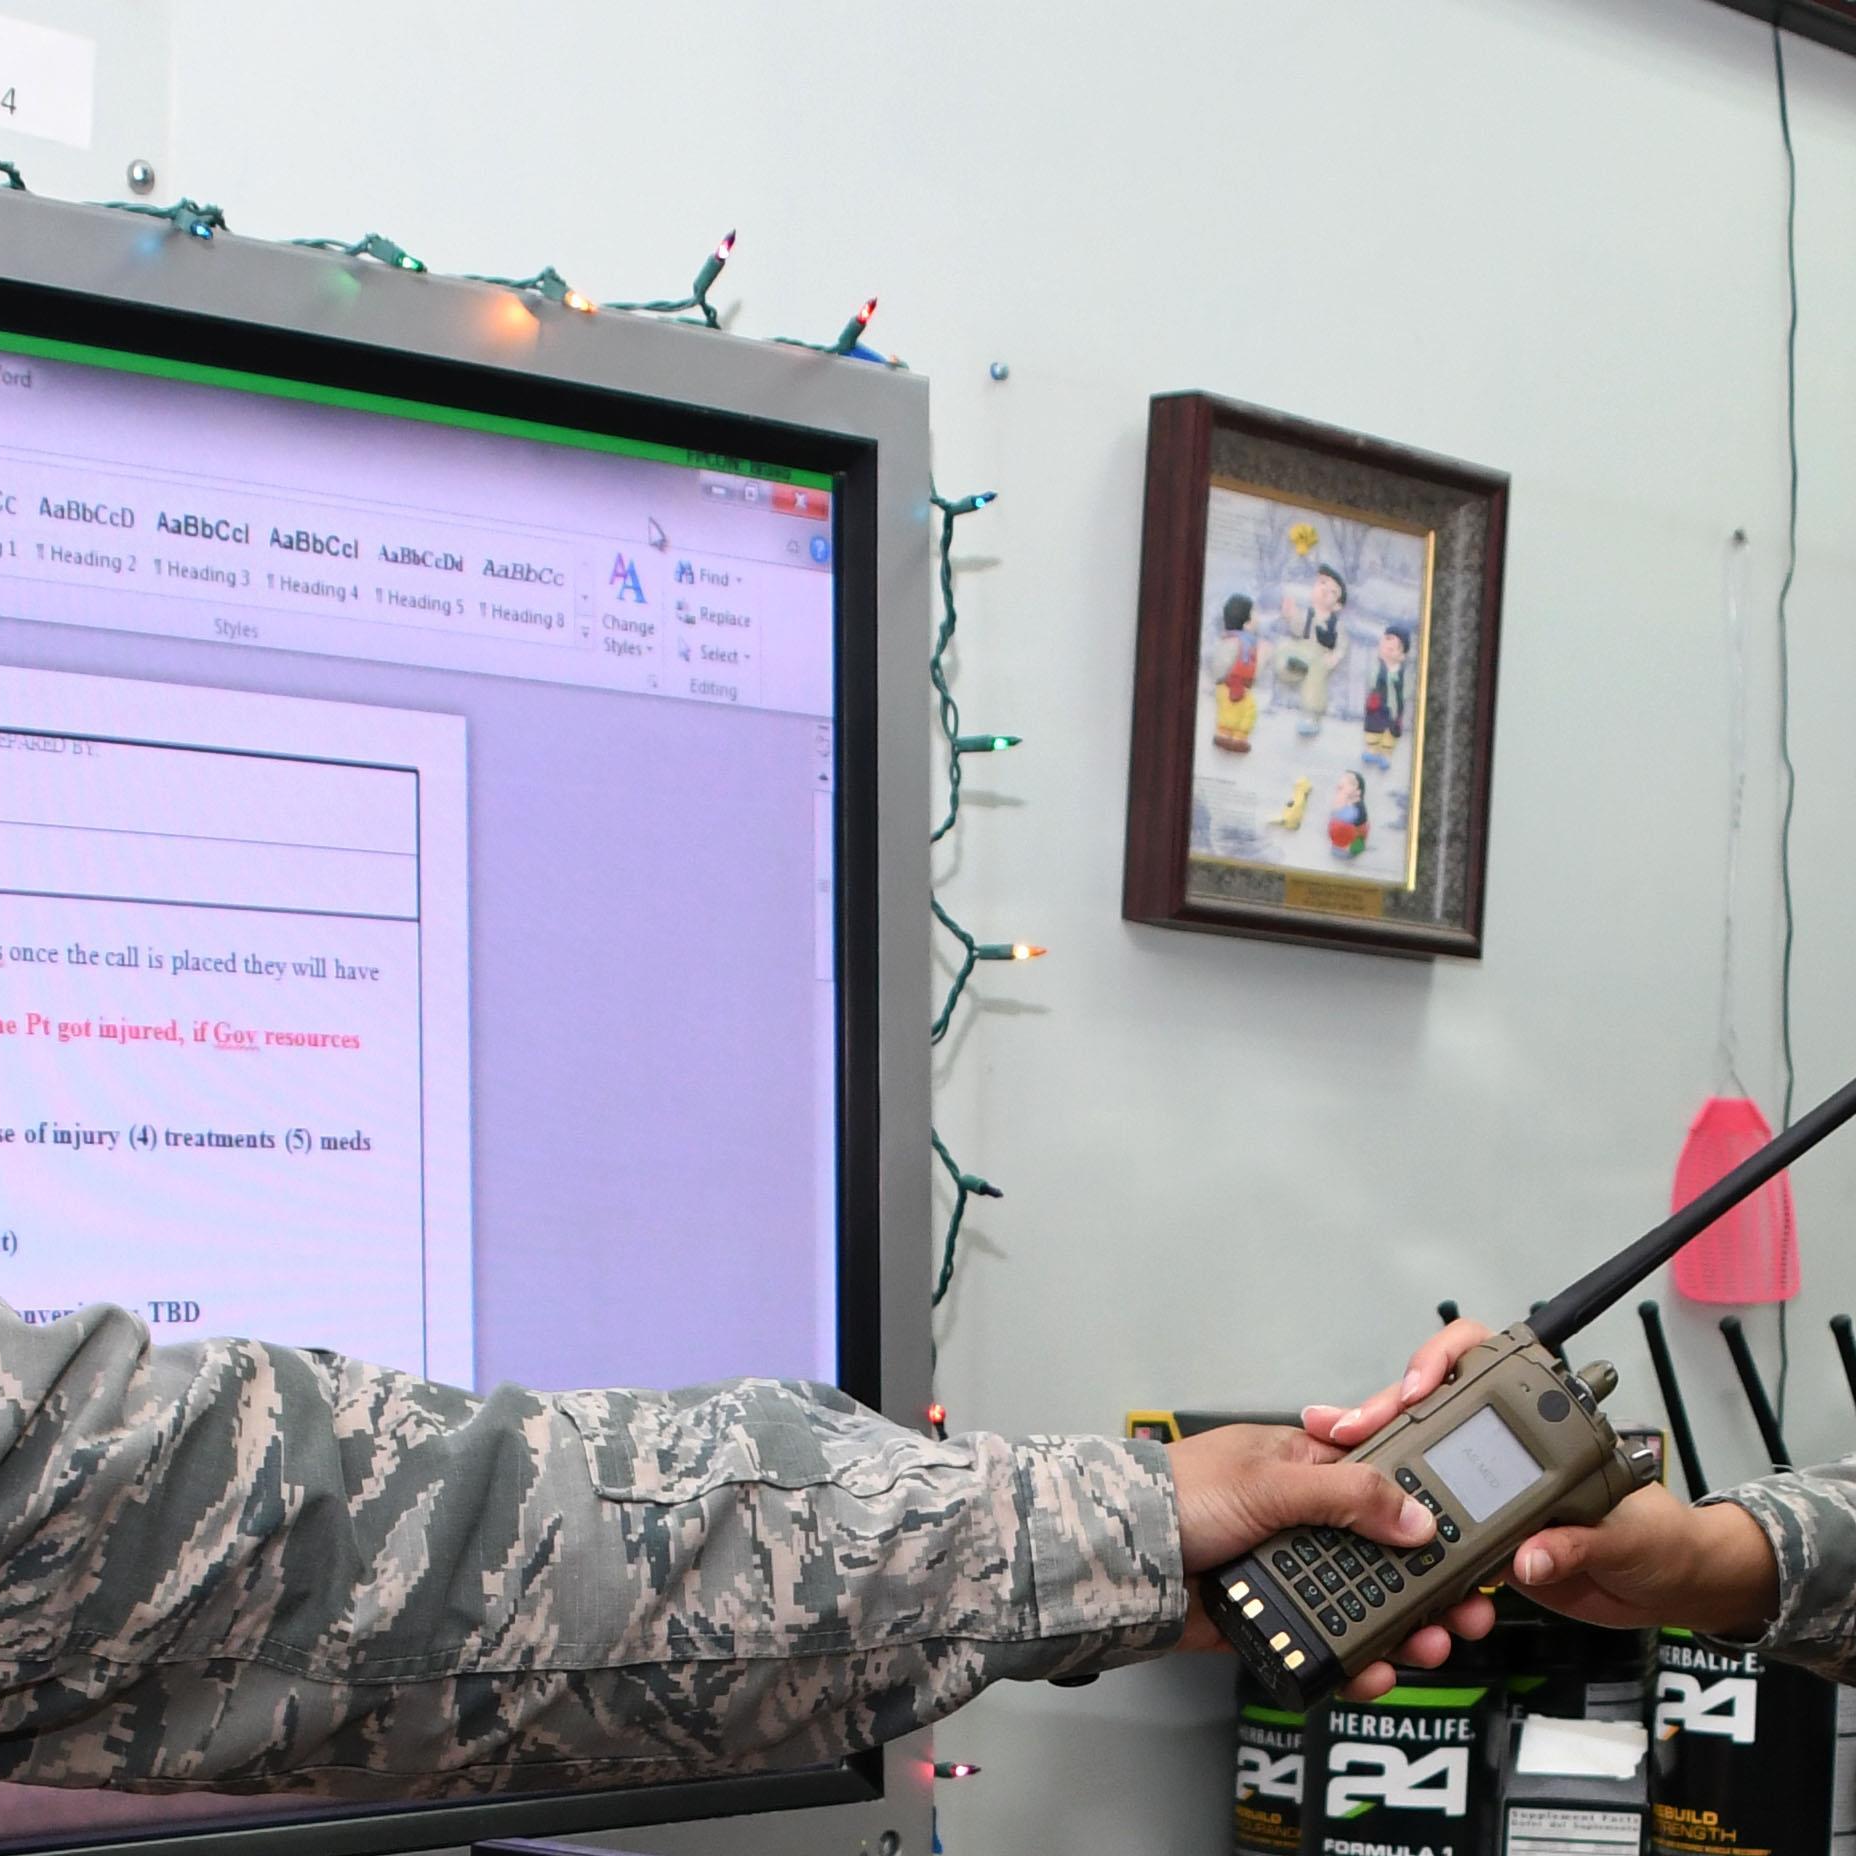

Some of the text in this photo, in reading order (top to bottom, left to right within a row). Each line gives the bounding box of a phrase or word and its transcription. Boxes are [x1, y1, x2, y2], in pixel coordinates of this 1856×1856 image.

[50, 545, 122, 573] Heading
[168, 561, 236, 588] Heading
[280, 576, 345, 603] Heading
[387, 589, 452, 616] Heading
[215, 618, 259, 639] Styles
[491, 604, 553, 630] Heading
[602, 613, 655, 636] Change
[699, 606, 751, 630] Replace
[9, 943, 58, 964] once
[67, 943, 99, 966] the
[105, 947, 139, 968] call
[172, 948, 236, 975] placed
[244, 952, 285, 980] they
[293, 956, 326, 978] will
[334, 959, 380, 982] have
[58, 1018, 92, 1041] got
[99, 1016, 184, 1046] injured,
[264, 1029, 360, 1049] resources
[24, 1121, 47, 1144] of
[53, 1122, 120, 1151] injury
[128, 1124, 157, 1151] (4)
[165, 1127, 275, 1150] treatments
[284, 1127, 312, 1154] (5)
[320, 1130, 371, 1151] meds
[148, 1300, 200, 1324] TBD
[1655, 1671, 1757, 1744] 24
[1329, 1711, 1471, 1740] HERBALIFE
[1236, 1746, 1304, 1804] 24
[1325, 1741, 1469, 1819] 24
